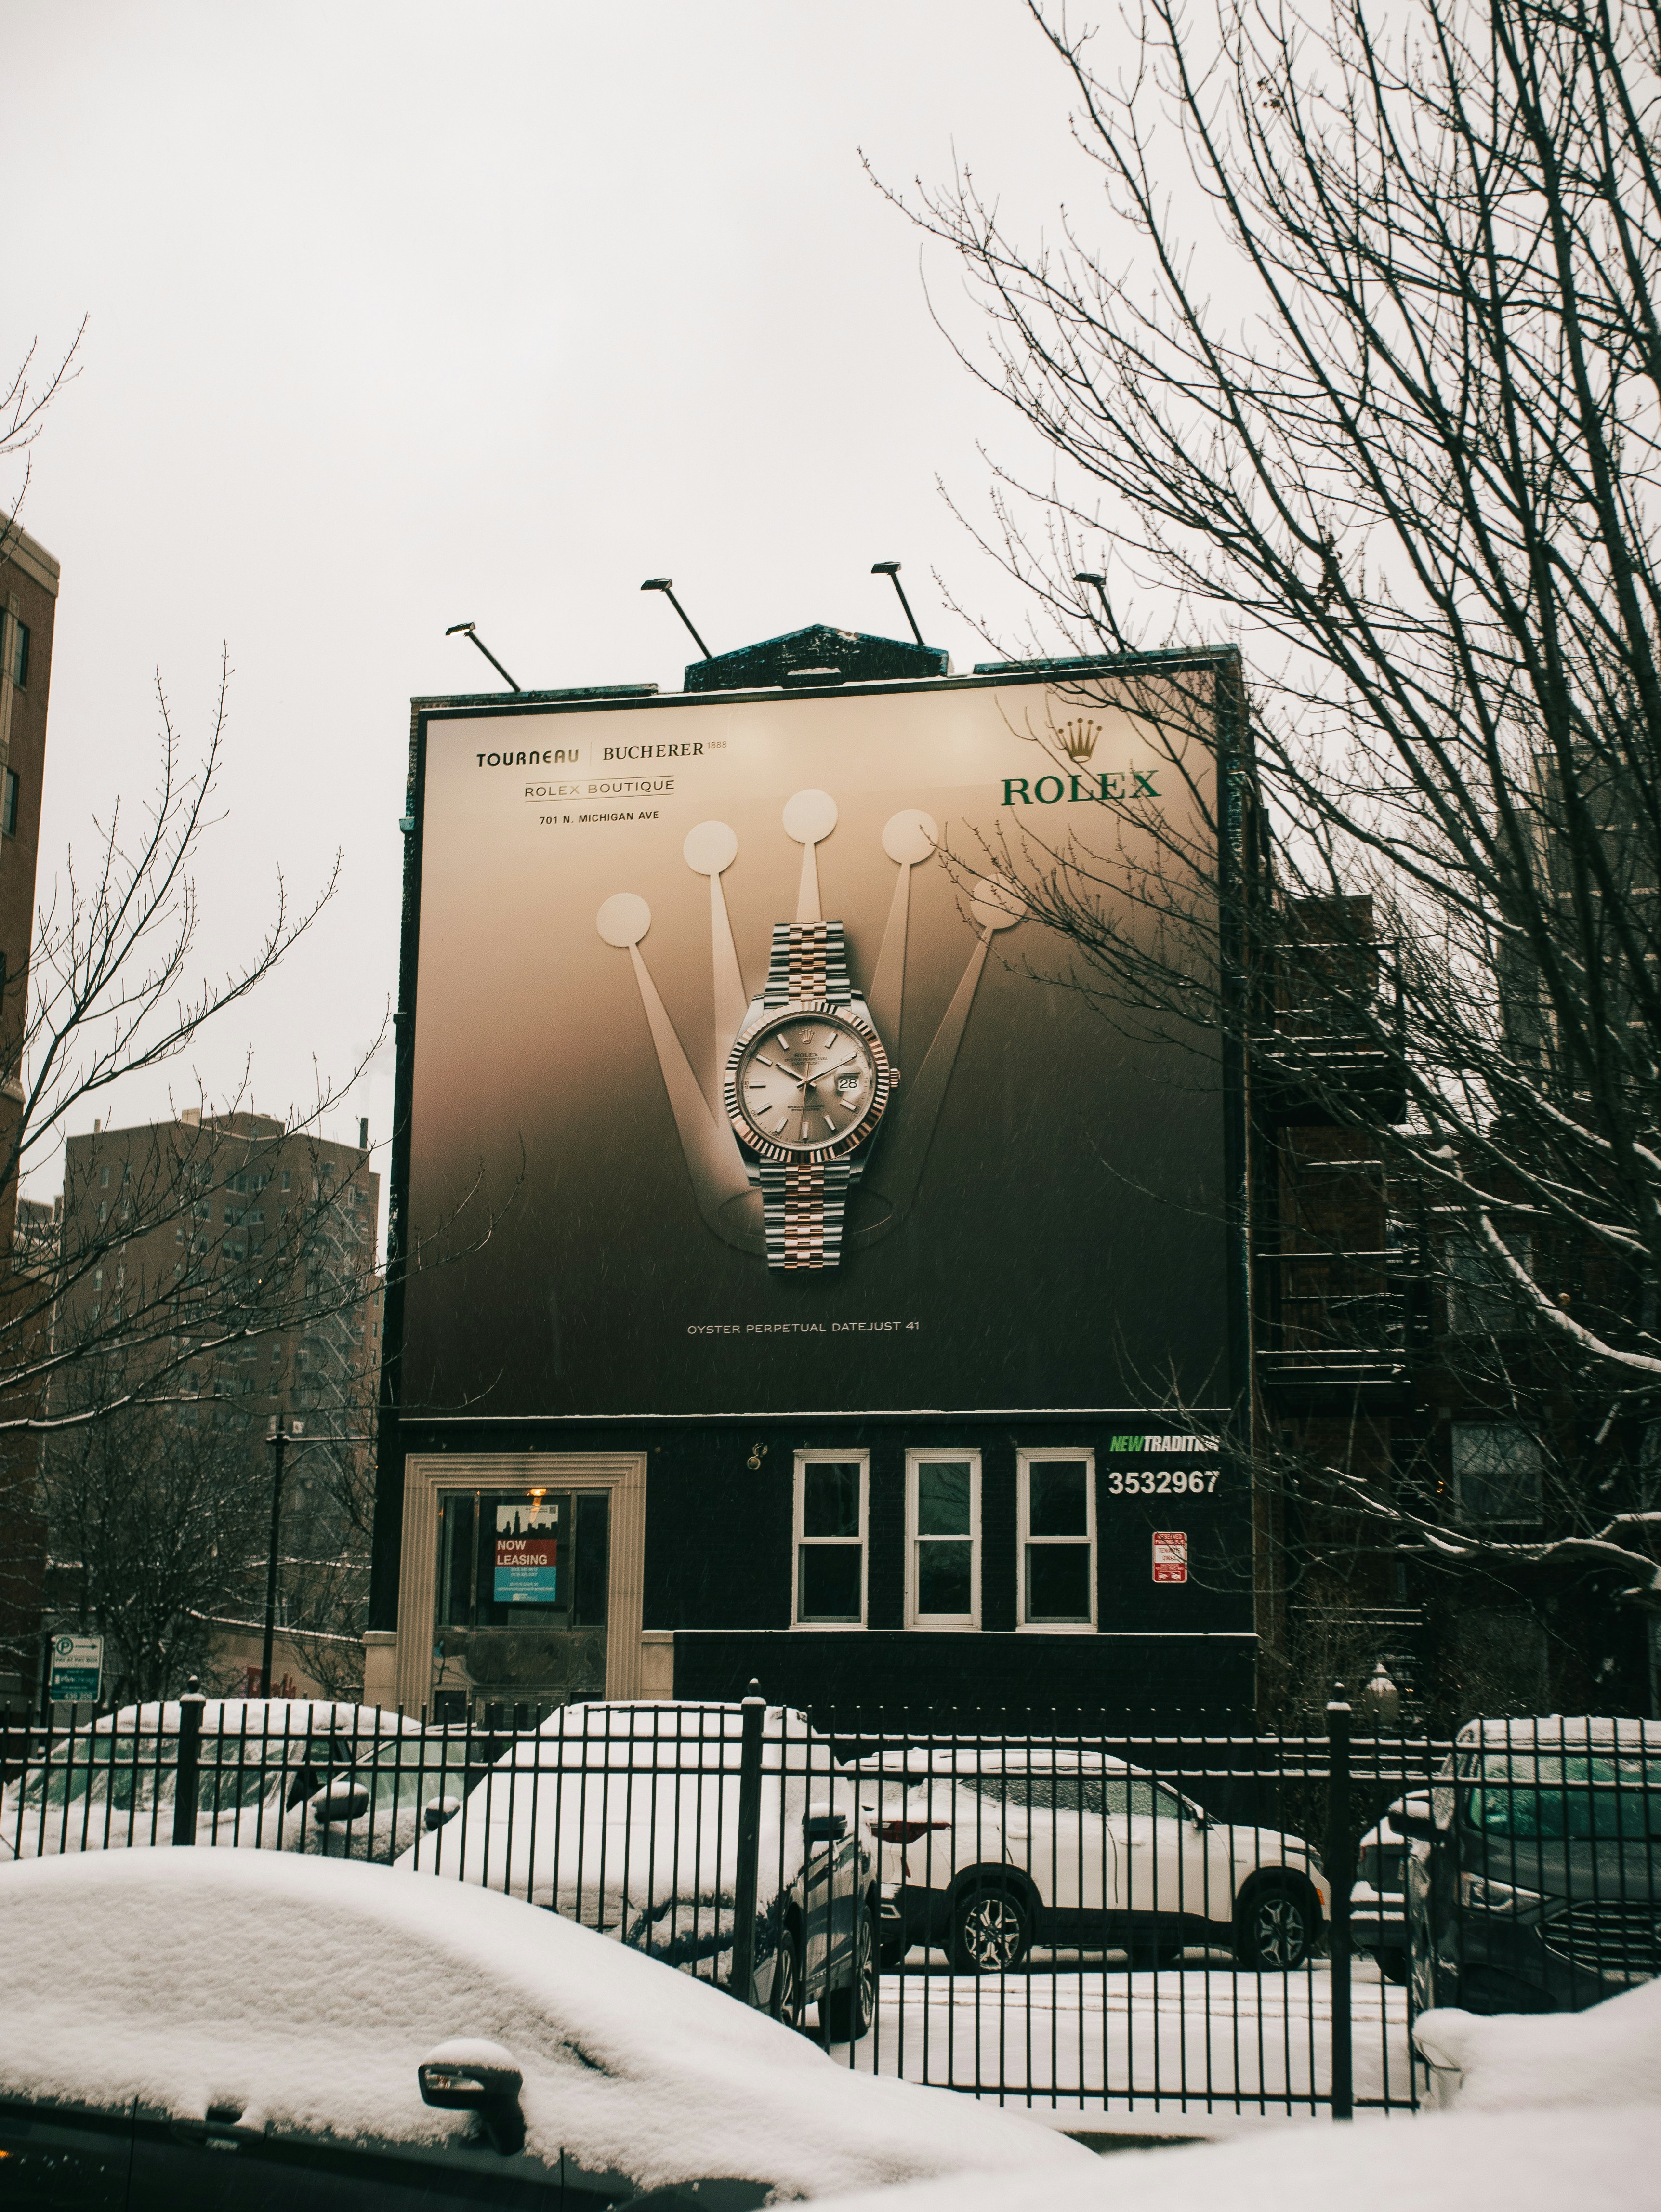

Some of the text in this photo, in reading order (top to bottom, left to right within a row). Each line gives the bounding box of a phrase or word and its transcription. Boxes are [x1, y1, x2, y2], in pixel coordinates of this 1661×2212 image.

[603, 740, 727, 761] BUCHERER 1888
[476, 749, 580, 767] TOURNEAU
[525, 779, 675, 797] ROLEX BOUTIQUE
[1001, 770, 1162, 806] ROLEX
[539, 811, 659, 825] 701 N. MICHIGAN AVE
[839, 1078, 857, 1089] 28
[687, 1321, 920, 1334] OYSTER PERPETUAL DATEJUST 41
[1108, 1471, 1220, 1494] 3532967
[497, 1540, 526, 1550] NOW
[497, 1554, 547, 1565] LEASING
[61, 1641, 70, 1652] P
